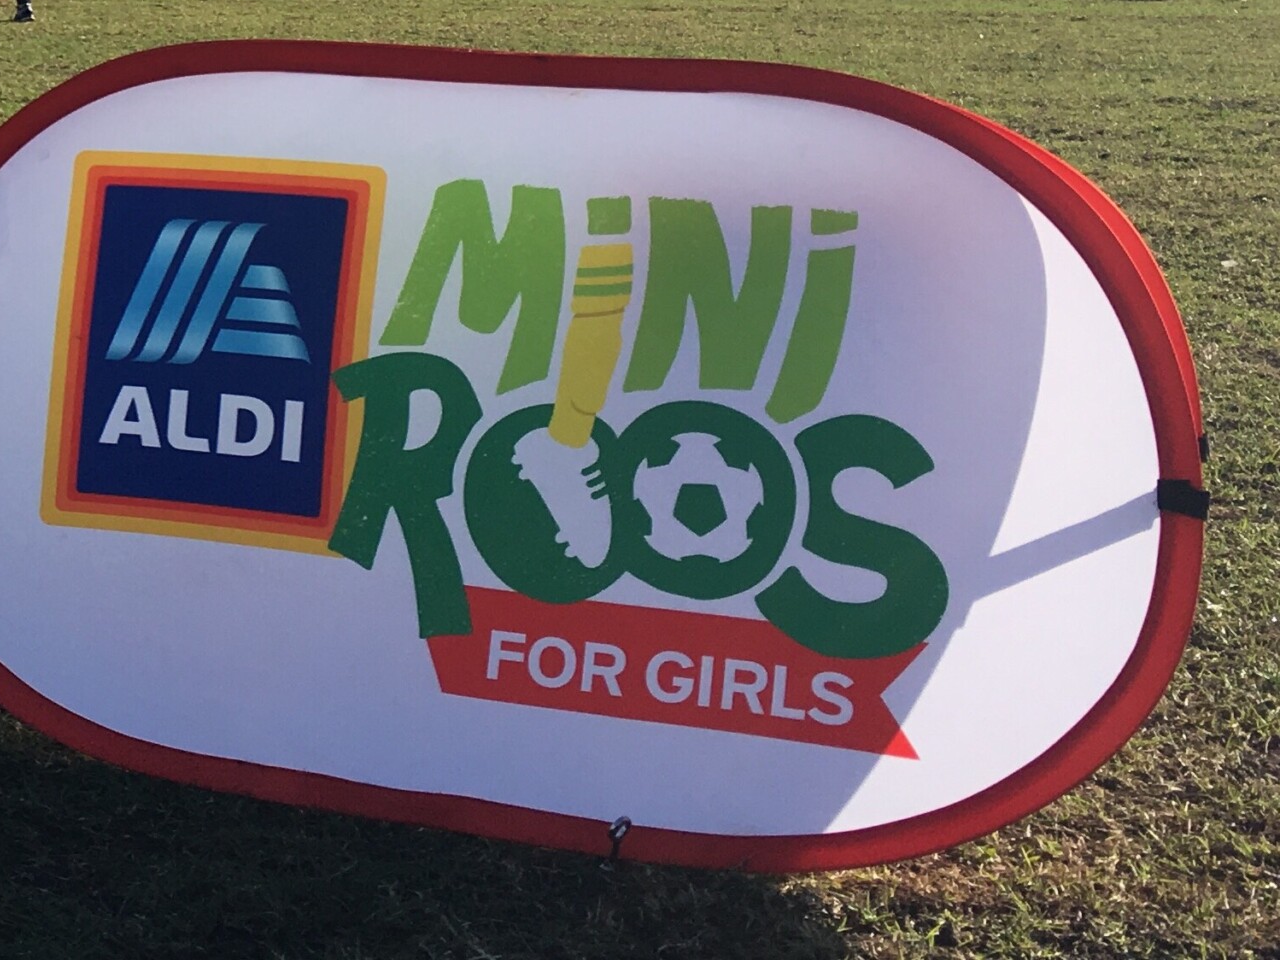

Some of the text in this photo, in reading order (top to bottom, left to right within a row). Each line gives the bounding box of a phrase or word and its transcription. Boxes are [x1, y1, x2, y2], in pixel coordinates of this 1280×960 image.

[98, 385, 305, 463] ALDI
[326, 351, 950, 660] ROOS
[485, 629, 855, 726] FOR GIRLS
